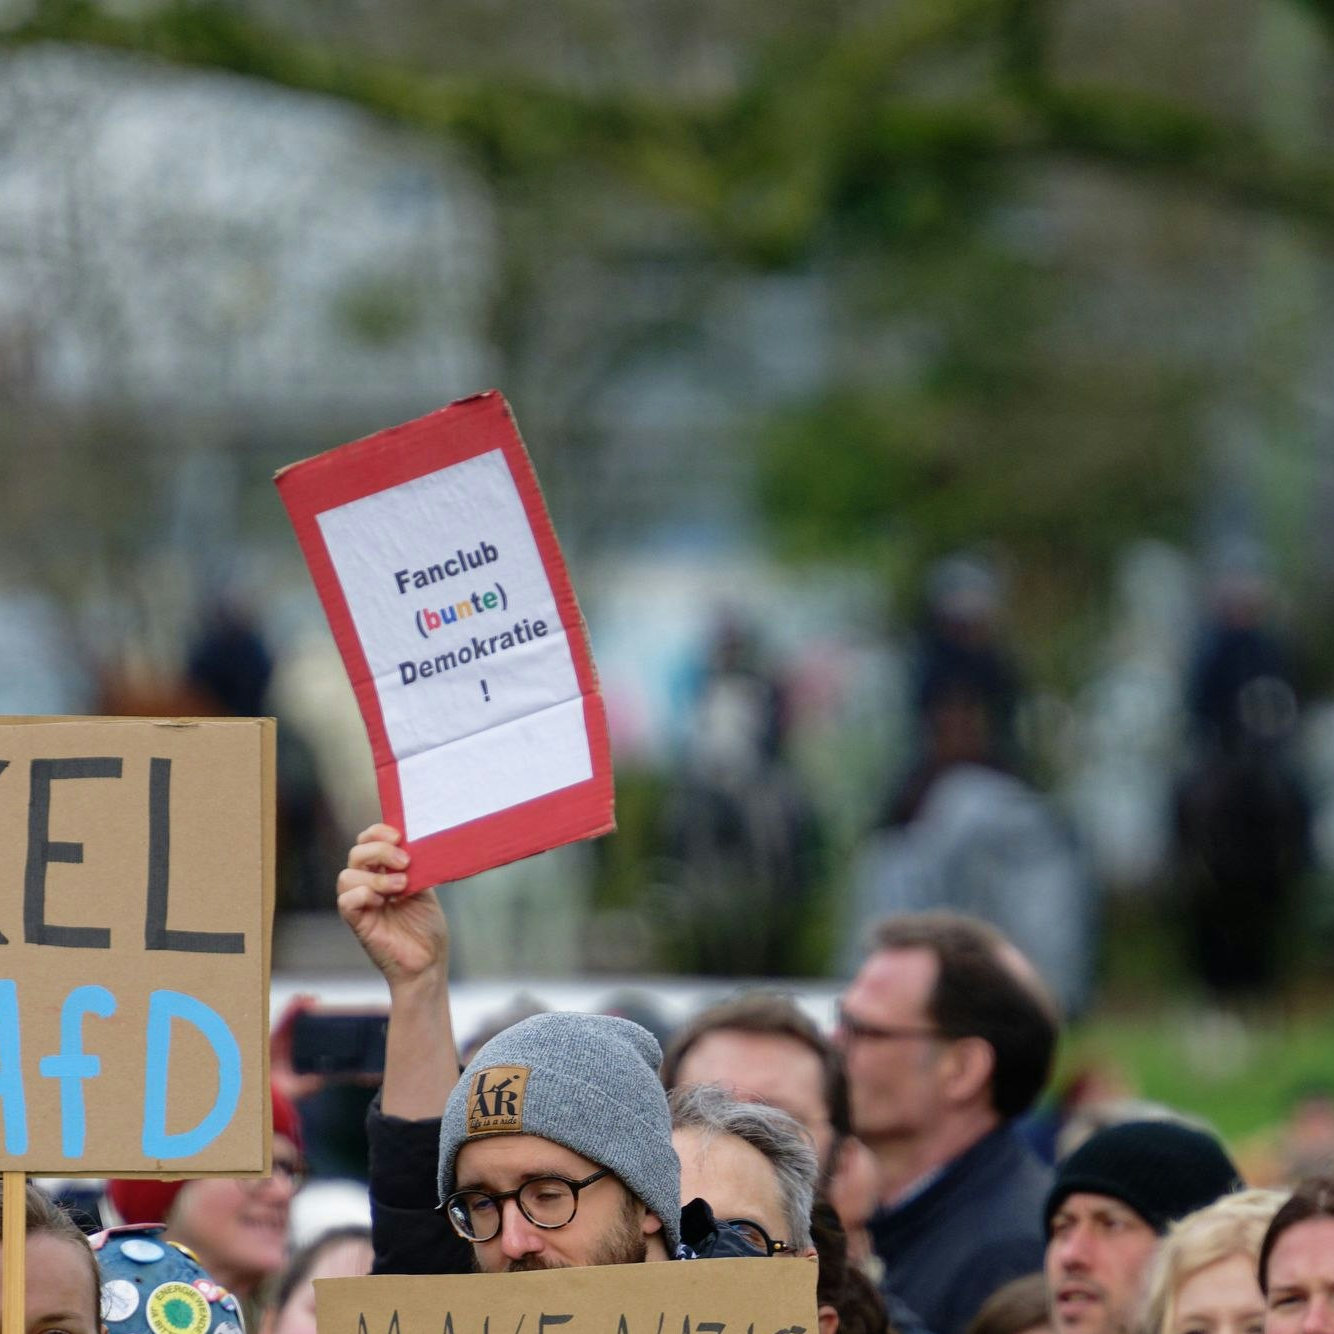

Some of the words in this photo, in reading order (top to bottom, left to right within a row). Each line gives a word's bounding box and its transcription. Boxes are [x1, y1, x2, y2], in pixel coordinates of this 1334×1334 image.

[393, 540, 500, 594] Fanclub
[415, 582, 509, 639] (bunte)
[398, 618, 549, 686] Demokratie
[479, 678, 490, 703] !
